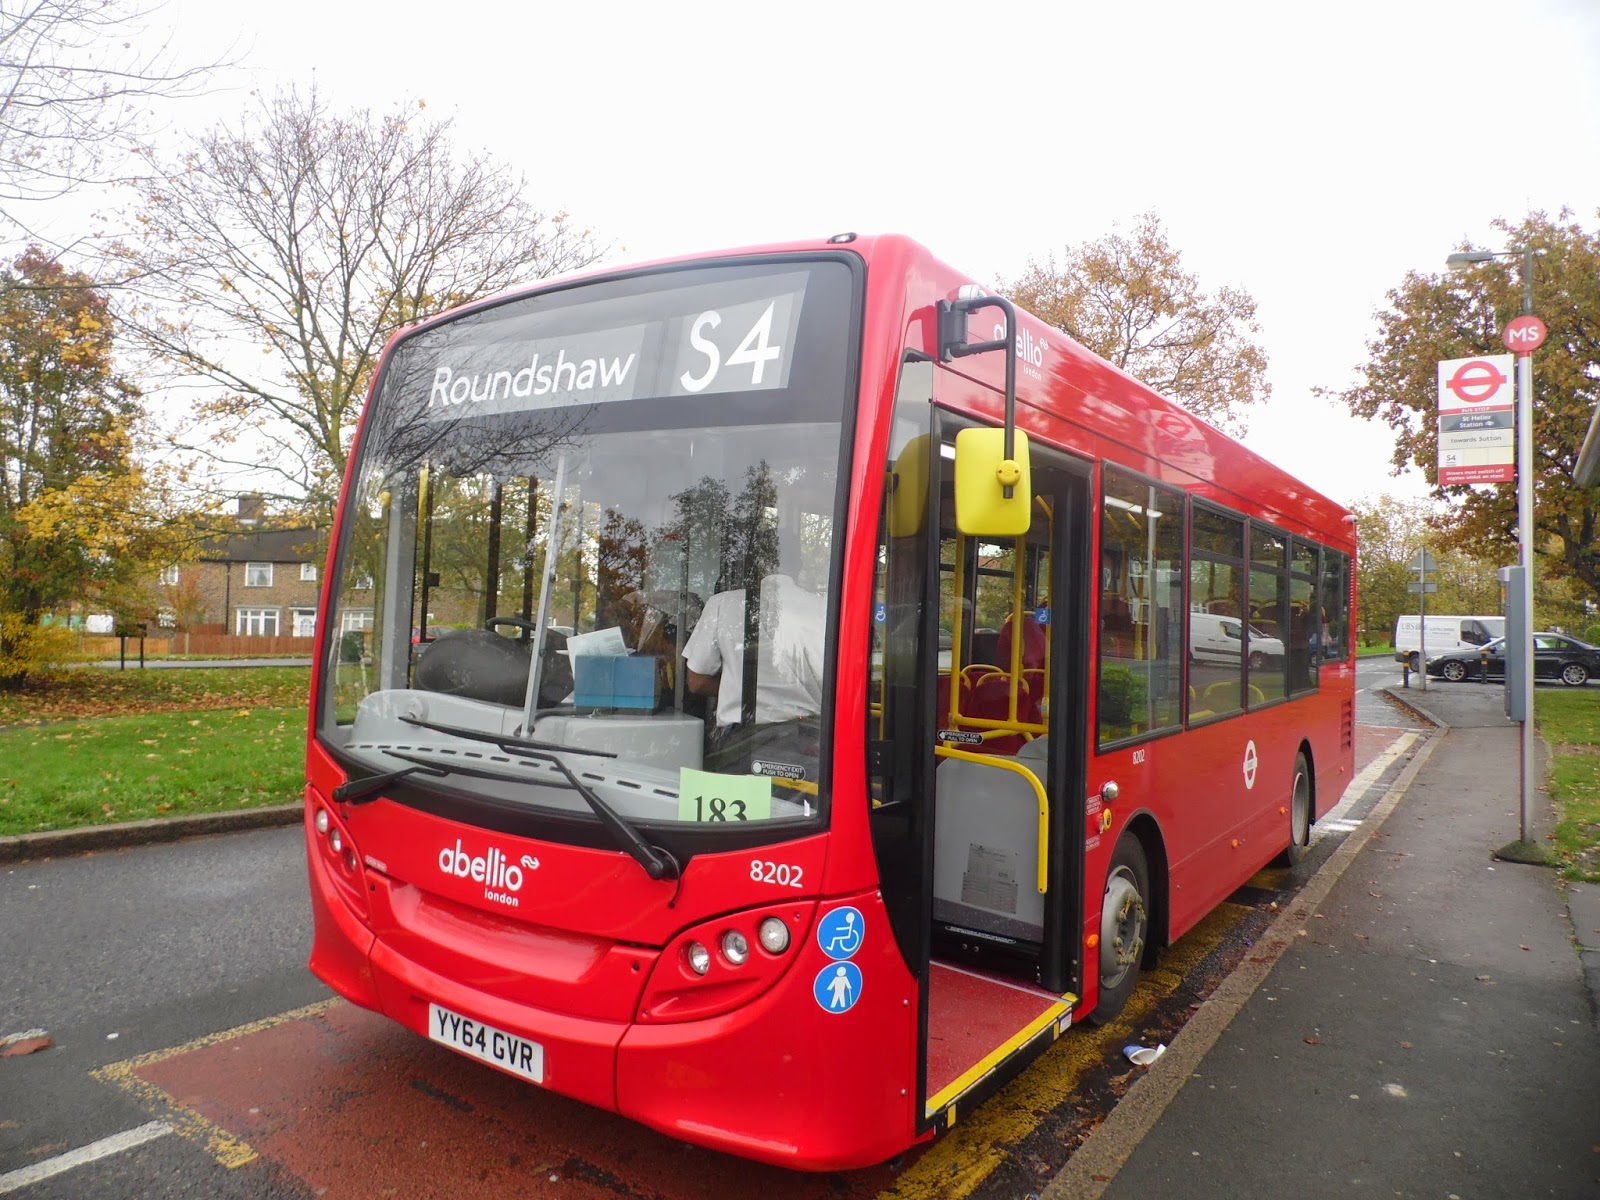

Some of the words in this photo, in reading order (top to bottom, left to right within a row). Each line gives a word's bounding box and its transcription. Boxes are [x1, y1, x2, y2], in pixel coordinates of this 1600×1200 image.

[993, 315, 1042, 368] aellio
[1508, 325, 1539, 344] MS
[428, 349, 635, 408] Roundshaw
[680, 300, 781, 393] S4
[1023, 364, 1042, 381] london
[1446, 454, 1456, 462] S4
[1133, 749, 1145, 765] 8202
[761, 763, 791, 772] EMERGENCY
[791, 766, 803, 774] EXIT
[785, 771, 799, 779] OPEN
[694, 796, 747, 822] 183
[439, 839, 523, 891] abellio
[750, 860, 803, 888] 8202
[484, 887, 519, 907] london
[437, 1009, 487, 1053] YY64
[493, 1031, 533, 1072] GVR
